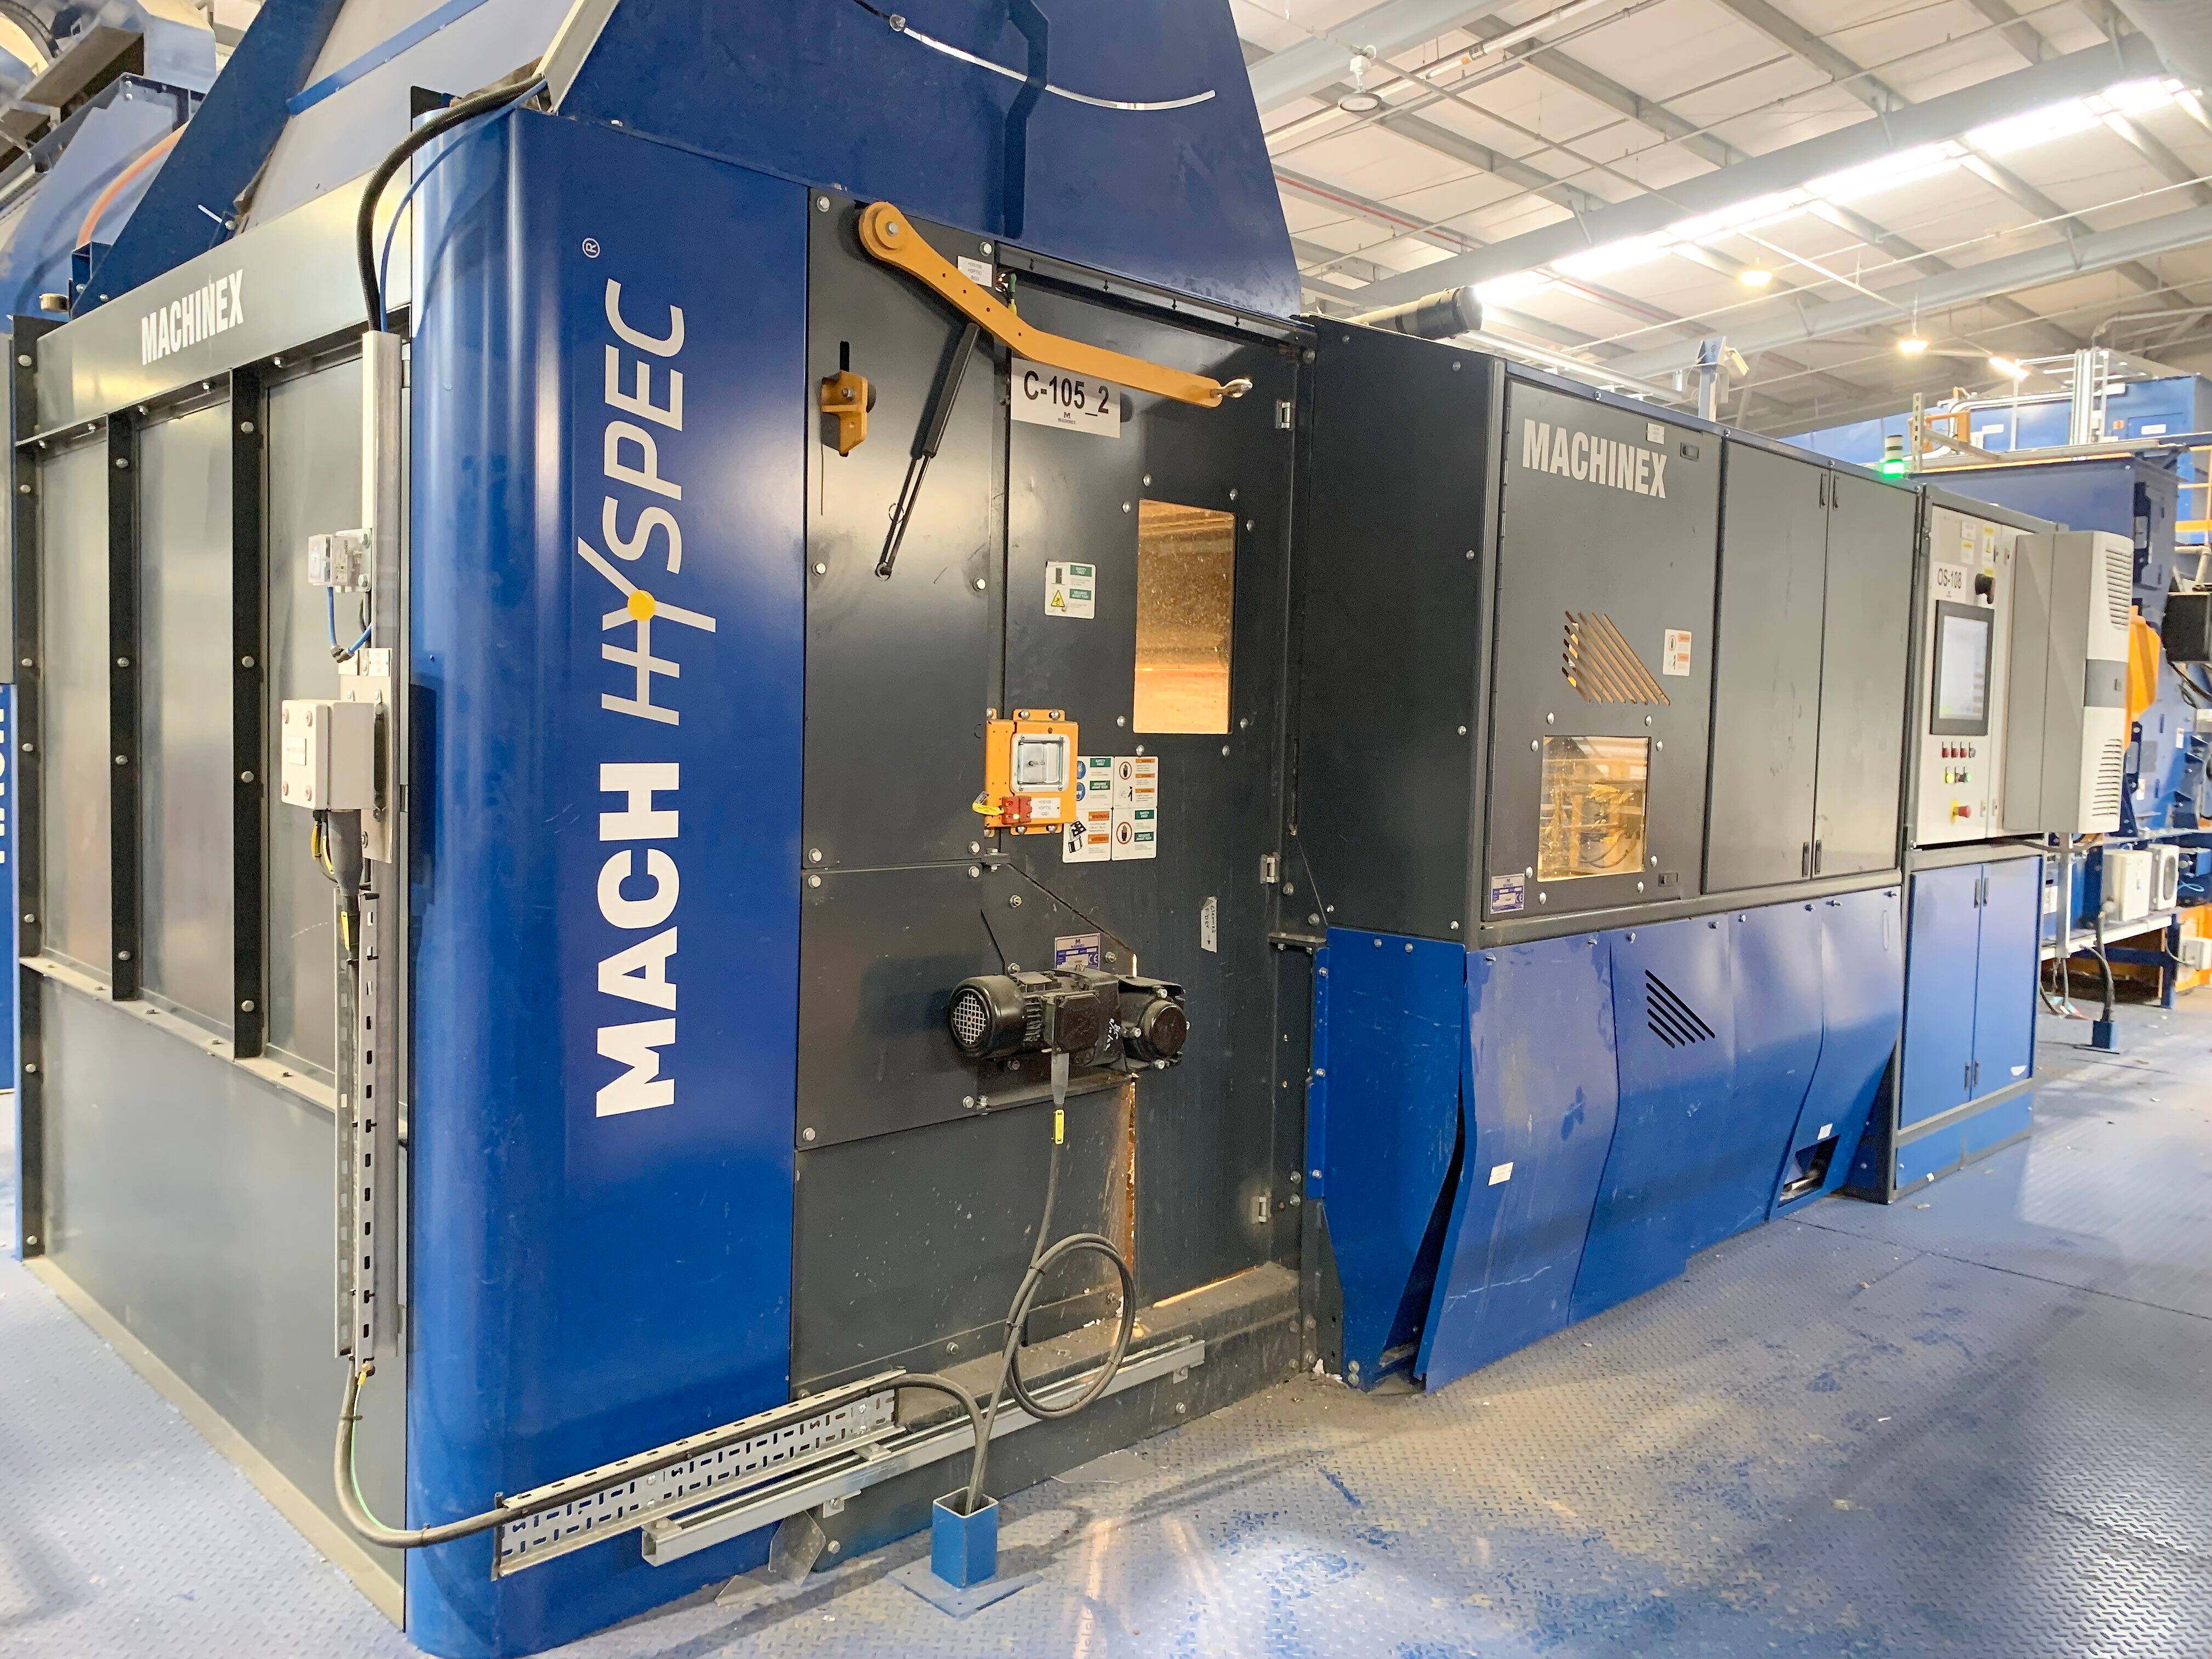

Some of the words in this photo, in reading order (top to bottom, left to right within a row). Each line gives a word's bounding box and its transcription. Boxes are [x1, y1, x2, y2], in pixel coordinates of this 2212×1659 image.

[142, 269, 244, 365] MACHINEX
[1024, 370, 1109, 417] C-105_2
[1522, 419, 1668, 499] MACHINEX
[1938, 568, 1962, 589] OS-108
[596, 762, 680, 1118] MACH
